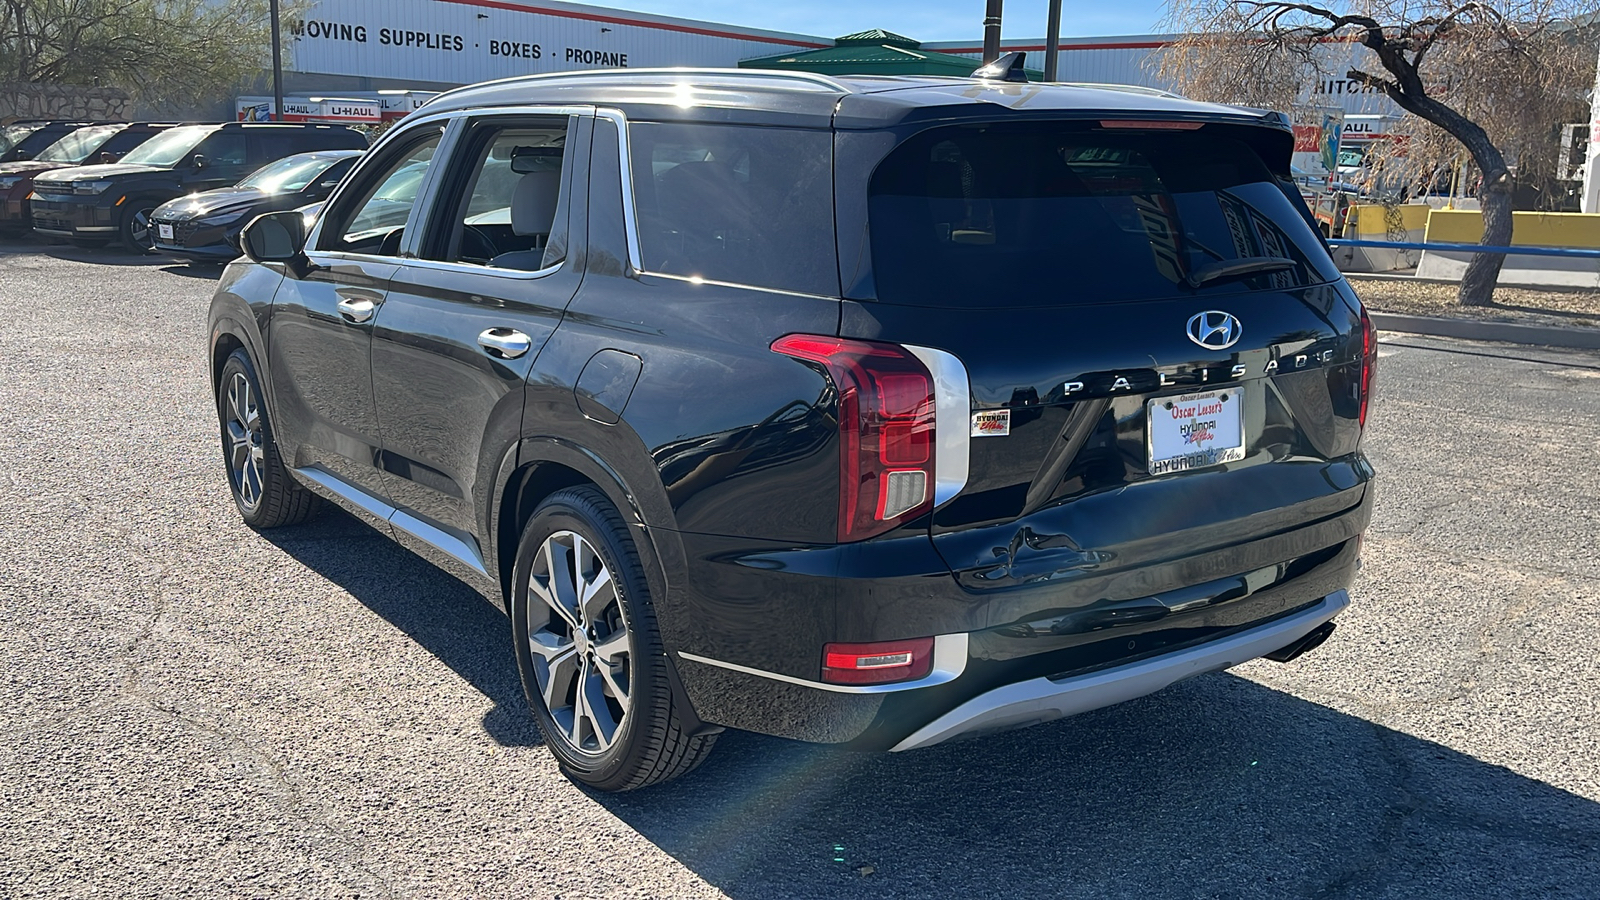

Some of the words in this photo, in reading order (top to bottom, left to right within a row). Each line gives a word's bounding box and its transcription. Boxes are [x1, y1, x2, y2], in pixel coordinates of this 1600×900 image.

[291, 20, 367, 43] MOVING
[379, 28, 464, 51] SUPPLIES
[489, 40, 542, 59] BOXES
[565, 47, 628, 68] PROPANE
[332, 107, 375, 117] U-HAUL
[1064, 349, 1334, 396] PALISADE
[1172, 405, 1196, 419] Oscar
[1180, 420, 1216, 434] HYUNDAI
[1154, 454, 1208, 474] HYUNDAI
